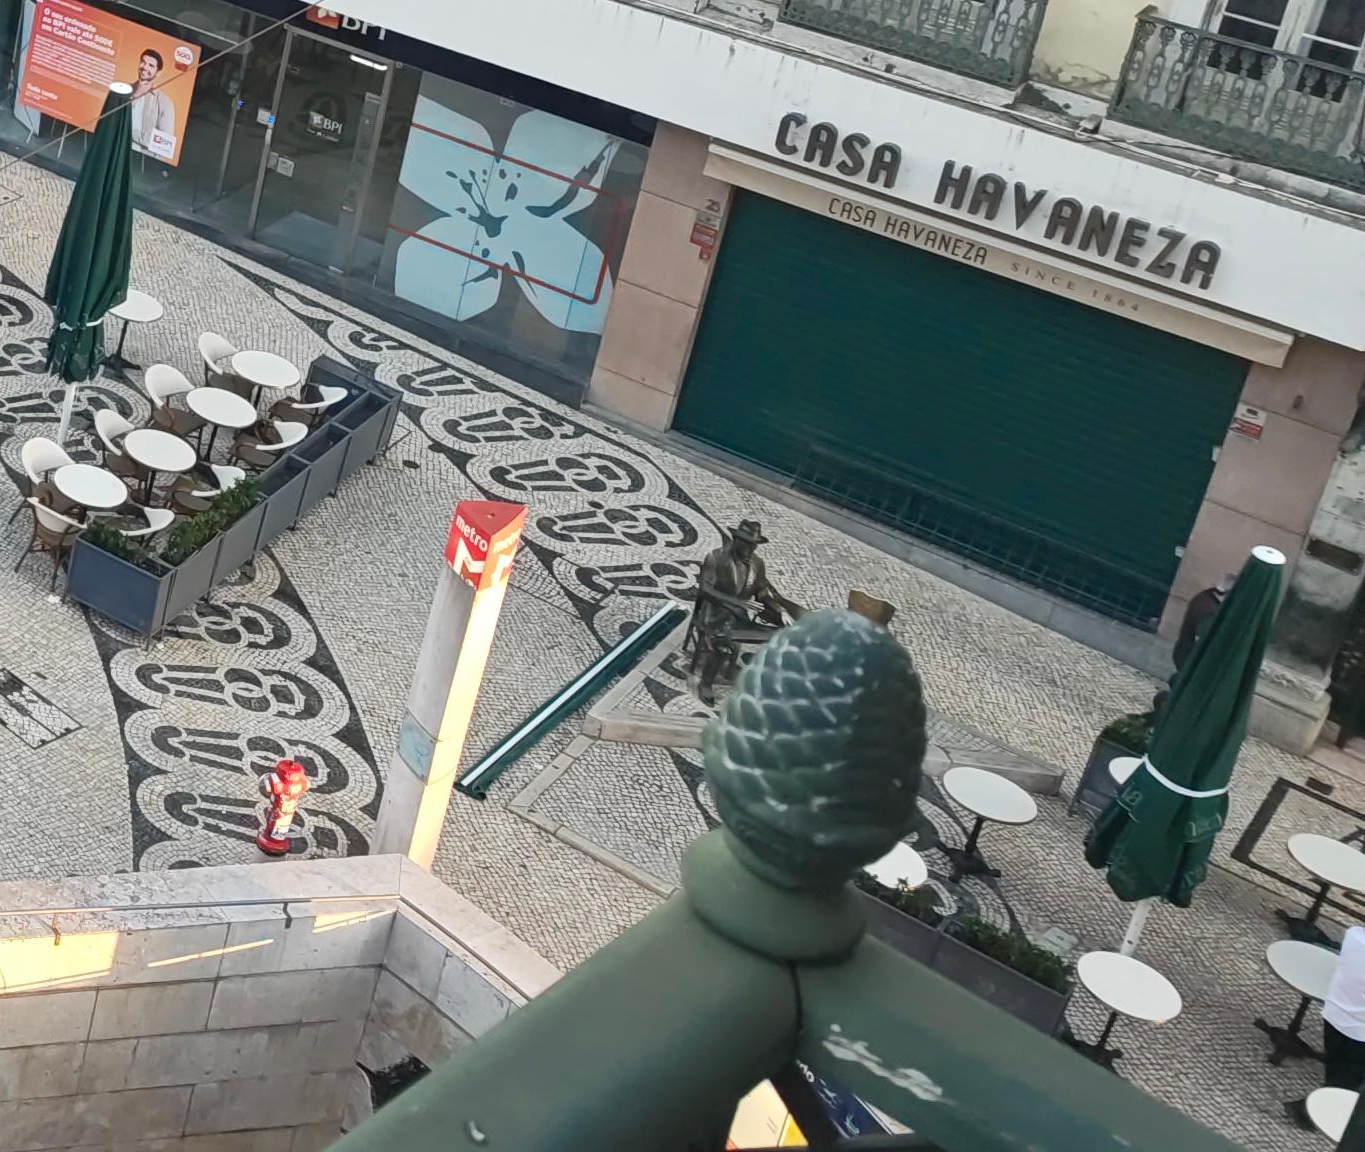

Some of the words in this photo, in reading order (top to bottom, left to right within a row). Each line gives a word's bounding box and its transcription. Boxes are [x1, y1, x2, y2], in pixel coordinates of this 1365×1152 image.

[774, 111, 903, 189] CASA
[933, 159, 1222, 291] HAVANEZA
[828, 197, 876, 227] CASA
[883, 216, 988, 266] HAVANEZA
[1009, 261, 1077, 293] SINCE
[1092, 288, 1142, 314] 1864
[455, 514, 489, 553] metro
